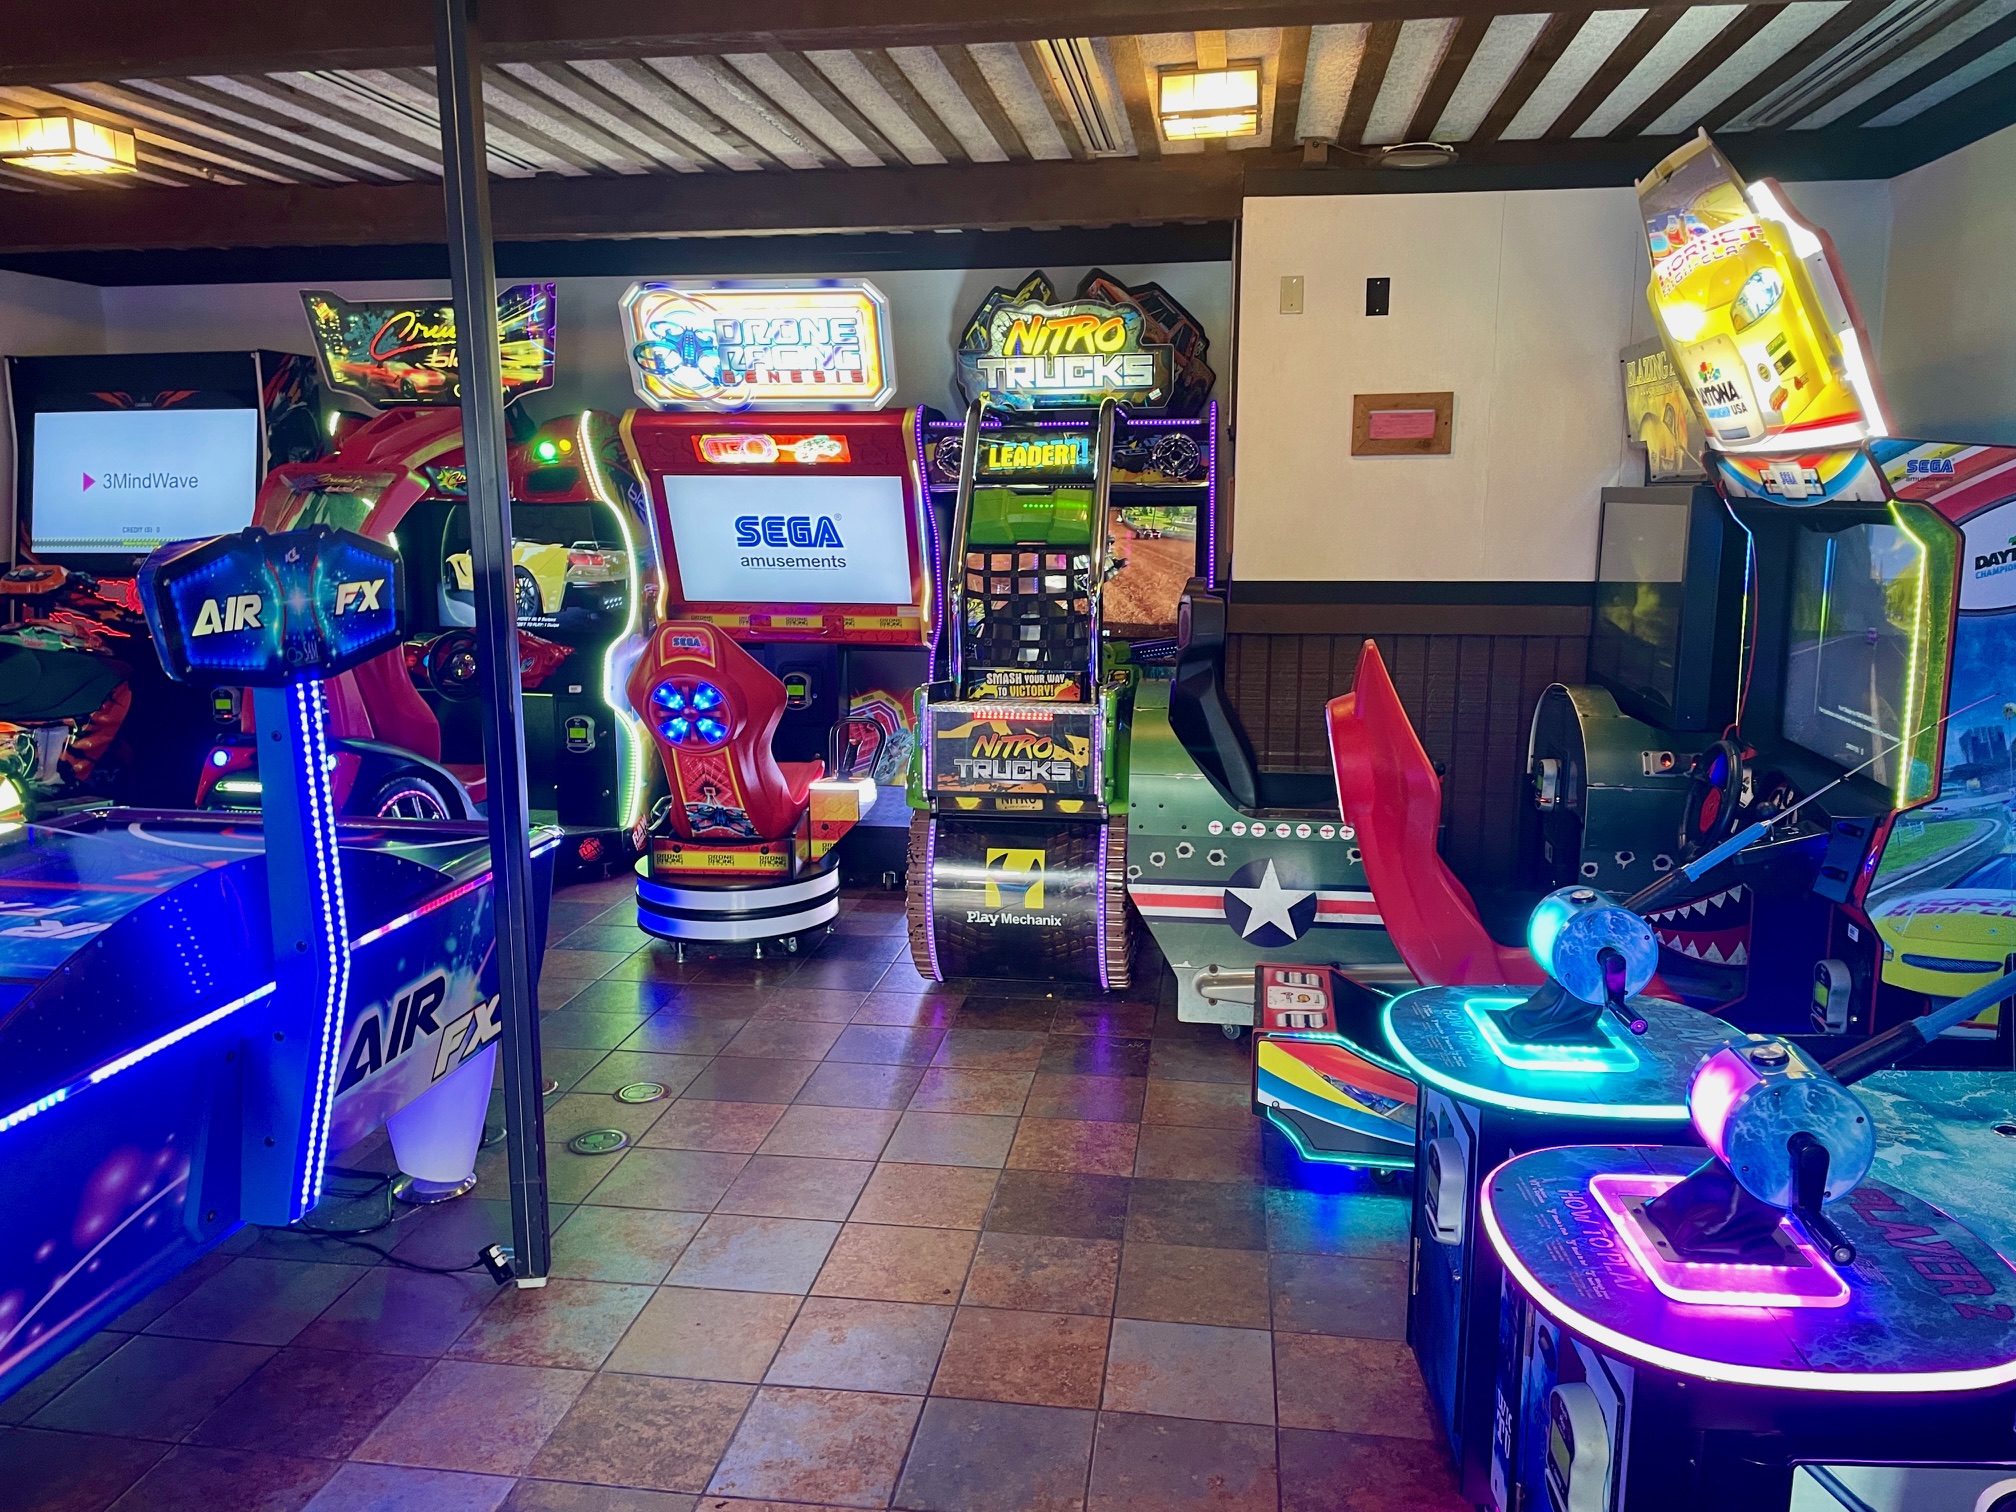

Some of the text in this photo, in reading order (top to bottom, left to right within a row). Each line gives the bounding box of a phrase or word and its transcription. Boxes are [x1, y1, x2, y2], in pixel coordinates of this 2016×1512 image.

[370, 311, 457, 361] Crui
[713, 317, 860, 345] DRONE
[723, 370, 864, 383] GENESIS
[977, 354, 1154, 388] TRUCKS
[1731, 402, 1748, 415] USA
[988, 443, 1079, 470] LEADER!
[1906, 459, 1954, 474] SEGA
[103, 472, 199, 490] 3MindWave
[734, 515, 845, 548] SEGA
[740, 555, 847, 568] amusements
[1974, 547, 2016, 571] DAYT
[1975, 562, 2016, 579] CHAMPIO
[191, 578, 385, 637] AIR FX
[672, 637, 702, 647] SEGA
[986, 673, 1066, 685] SMASH YOUR WAY
[997, 684, 1055, 697] TO VICTORY!
[971, 733, 1054, 760] NITRO
[954, 758, 1073, 782] TRUCKS
[966, 911, 1062, 926] Play Mechanix
[334, 974, 502, 1099] AIR FX
[1557, 1189, 1600, 1225] HOW
[1582, 1228, 1615, 1249] TO
[1849, 1187, 1996, 1297] PLAYER
